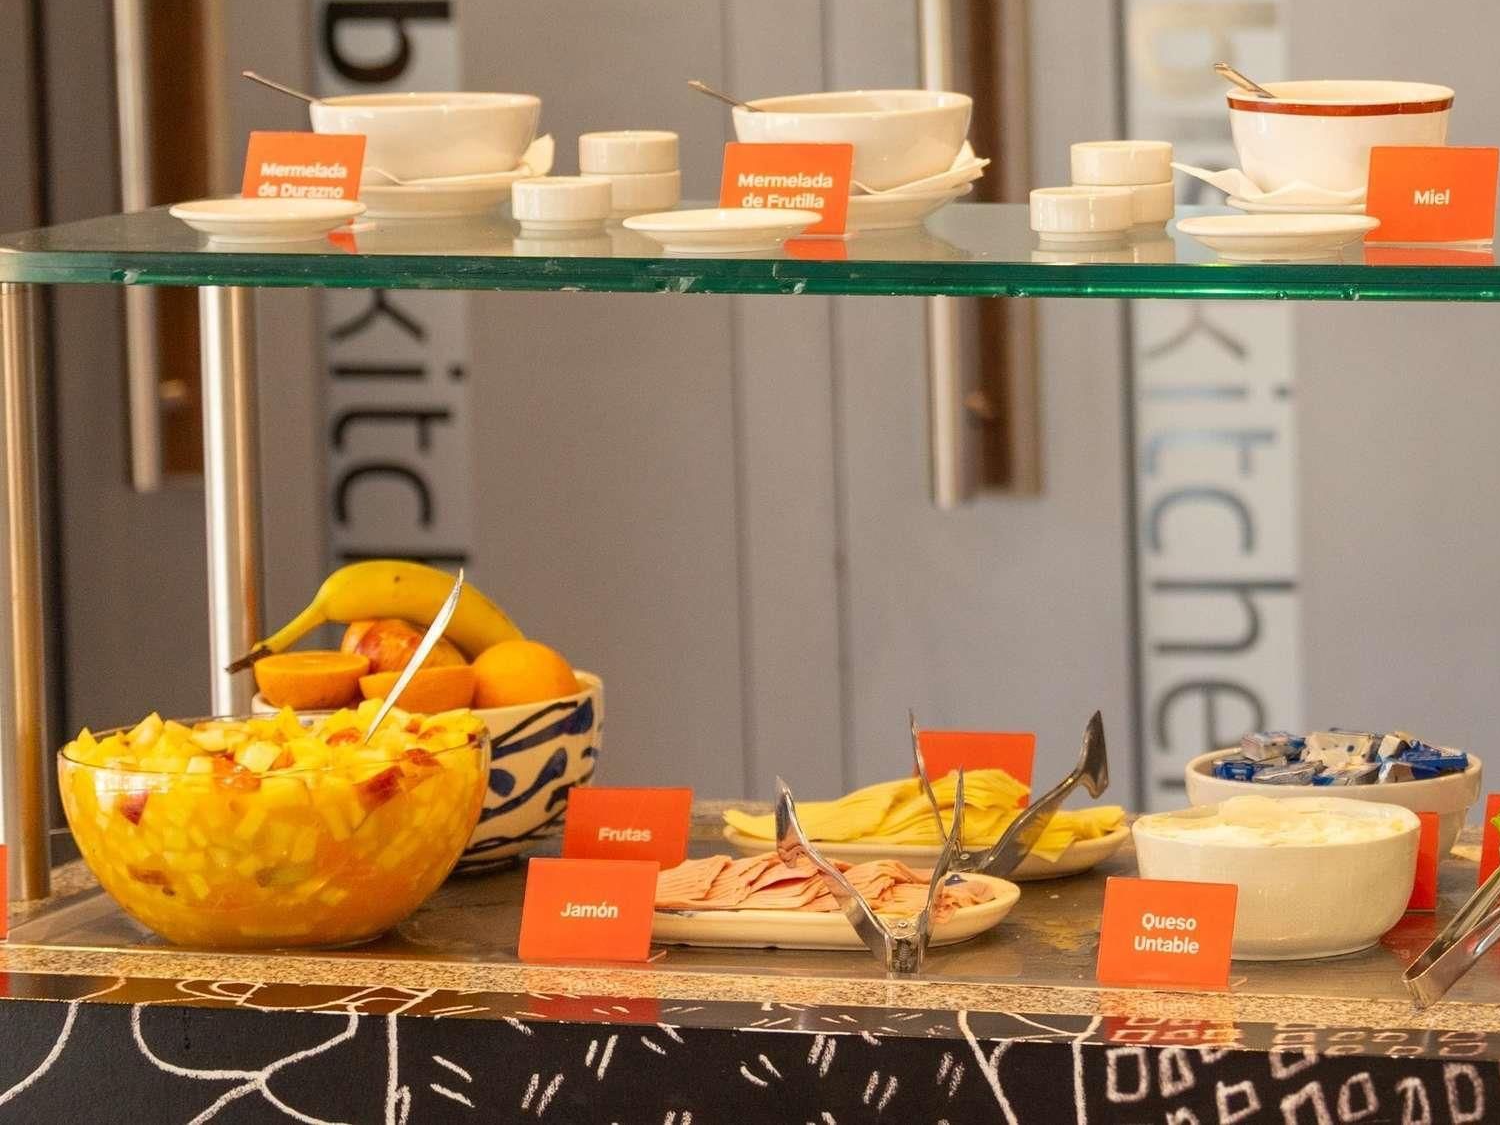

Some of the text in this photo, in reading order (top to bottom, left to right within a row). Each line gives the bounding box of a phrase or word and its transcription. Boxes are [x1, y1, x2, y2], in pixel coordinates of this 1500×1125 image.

[260, 162, 347, 179] Mermelada
[738, 172, 833, 188] Mermelada
[257, 182, 344, 198] de Durazno
[1414, 189, 1450, 205] Miel
[742, 194, 825, 208] de Frutilla
[1144, 298, 1297, 791] kitche
[598, 826, 652, 843] Frutas
[560, 901, 619, 919] Jamón
[1141, 912, 1197, 931] Queso
[1134, 935, 1200, 955] Untable
